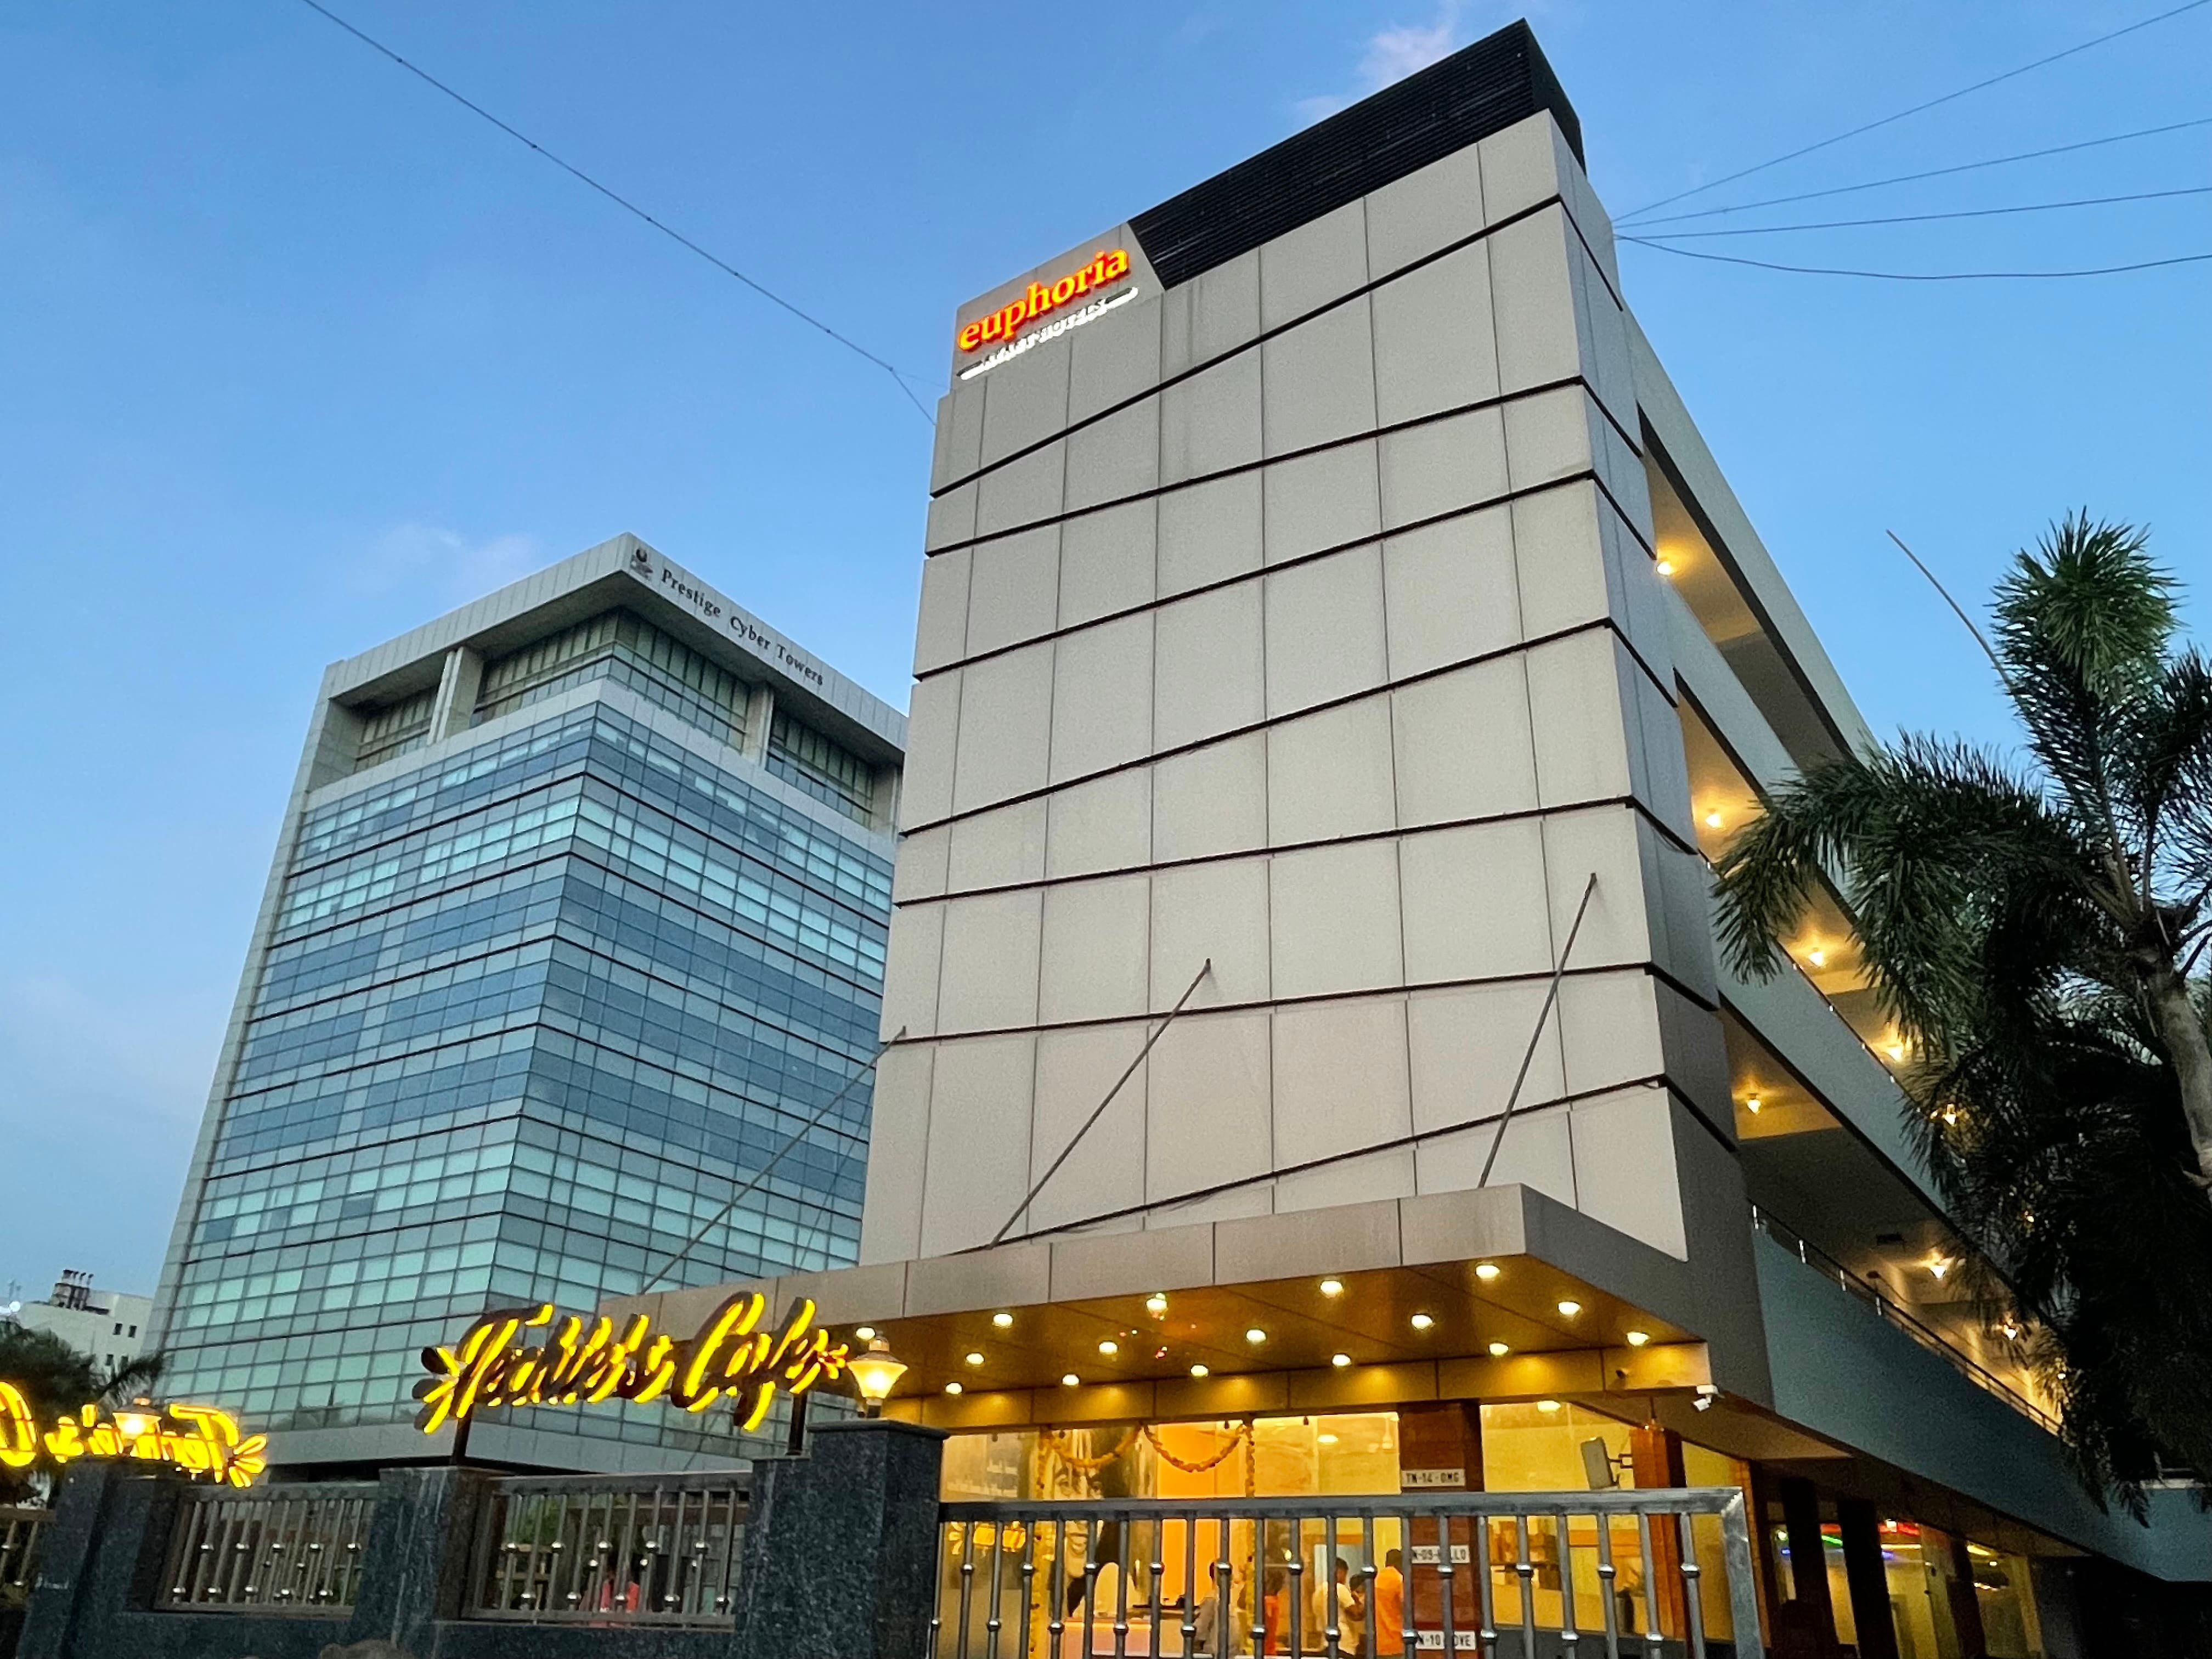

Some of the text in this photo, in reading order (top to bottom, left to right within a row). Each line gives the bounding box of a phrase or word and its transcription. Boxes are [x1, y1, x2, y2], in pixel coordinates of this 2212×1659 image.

[958, 249, 1128, 350] euphoria
[661, 568, 823, 686] Prestige Cyber Towers
